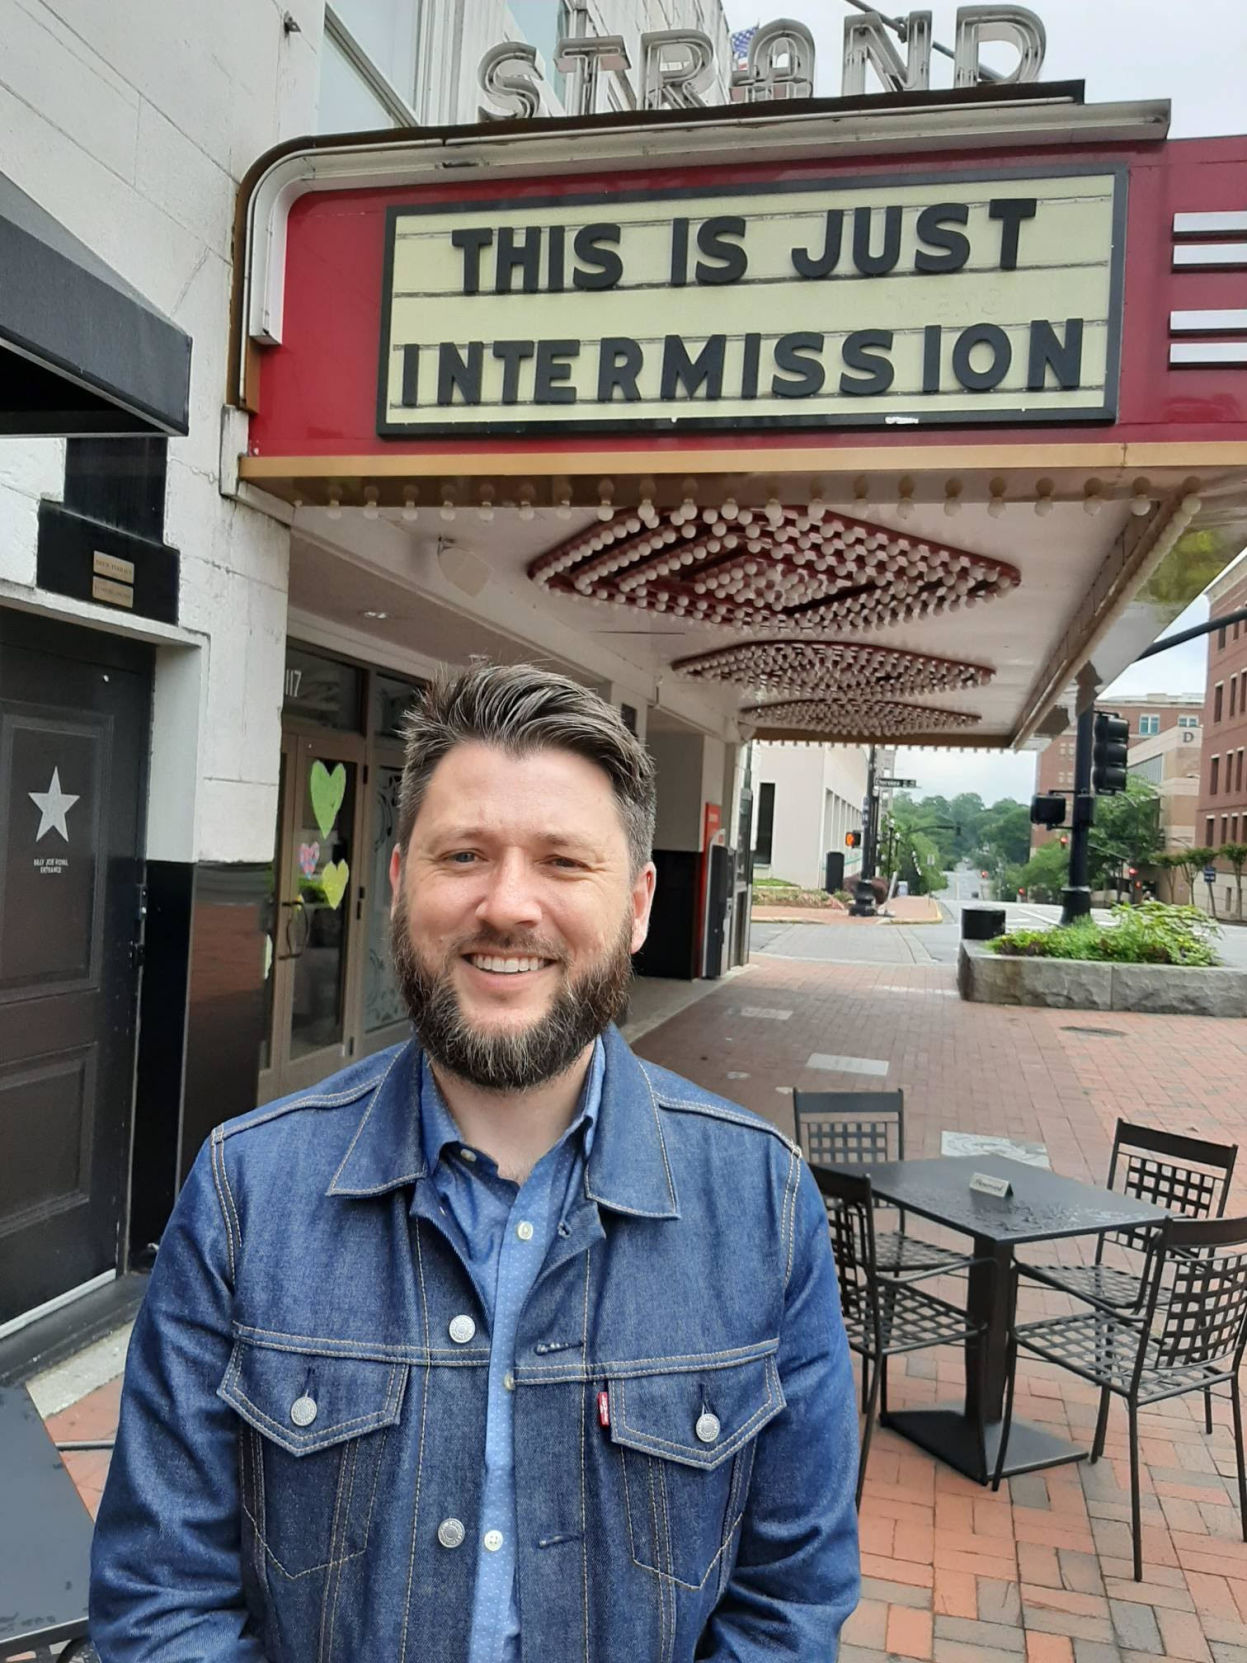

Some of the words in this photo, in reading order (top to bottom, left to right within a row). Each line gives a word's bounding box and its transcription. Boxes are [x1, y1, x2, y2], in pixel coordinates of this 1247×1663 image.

[476, 4, 1047, 124] STRAND
[451, 222, 624, 294] THIS
[670, 215, 748, 287] IS
[790, 198, 1038, 279] JUST
[401, 318, 1084, 406] INTERMISSION
